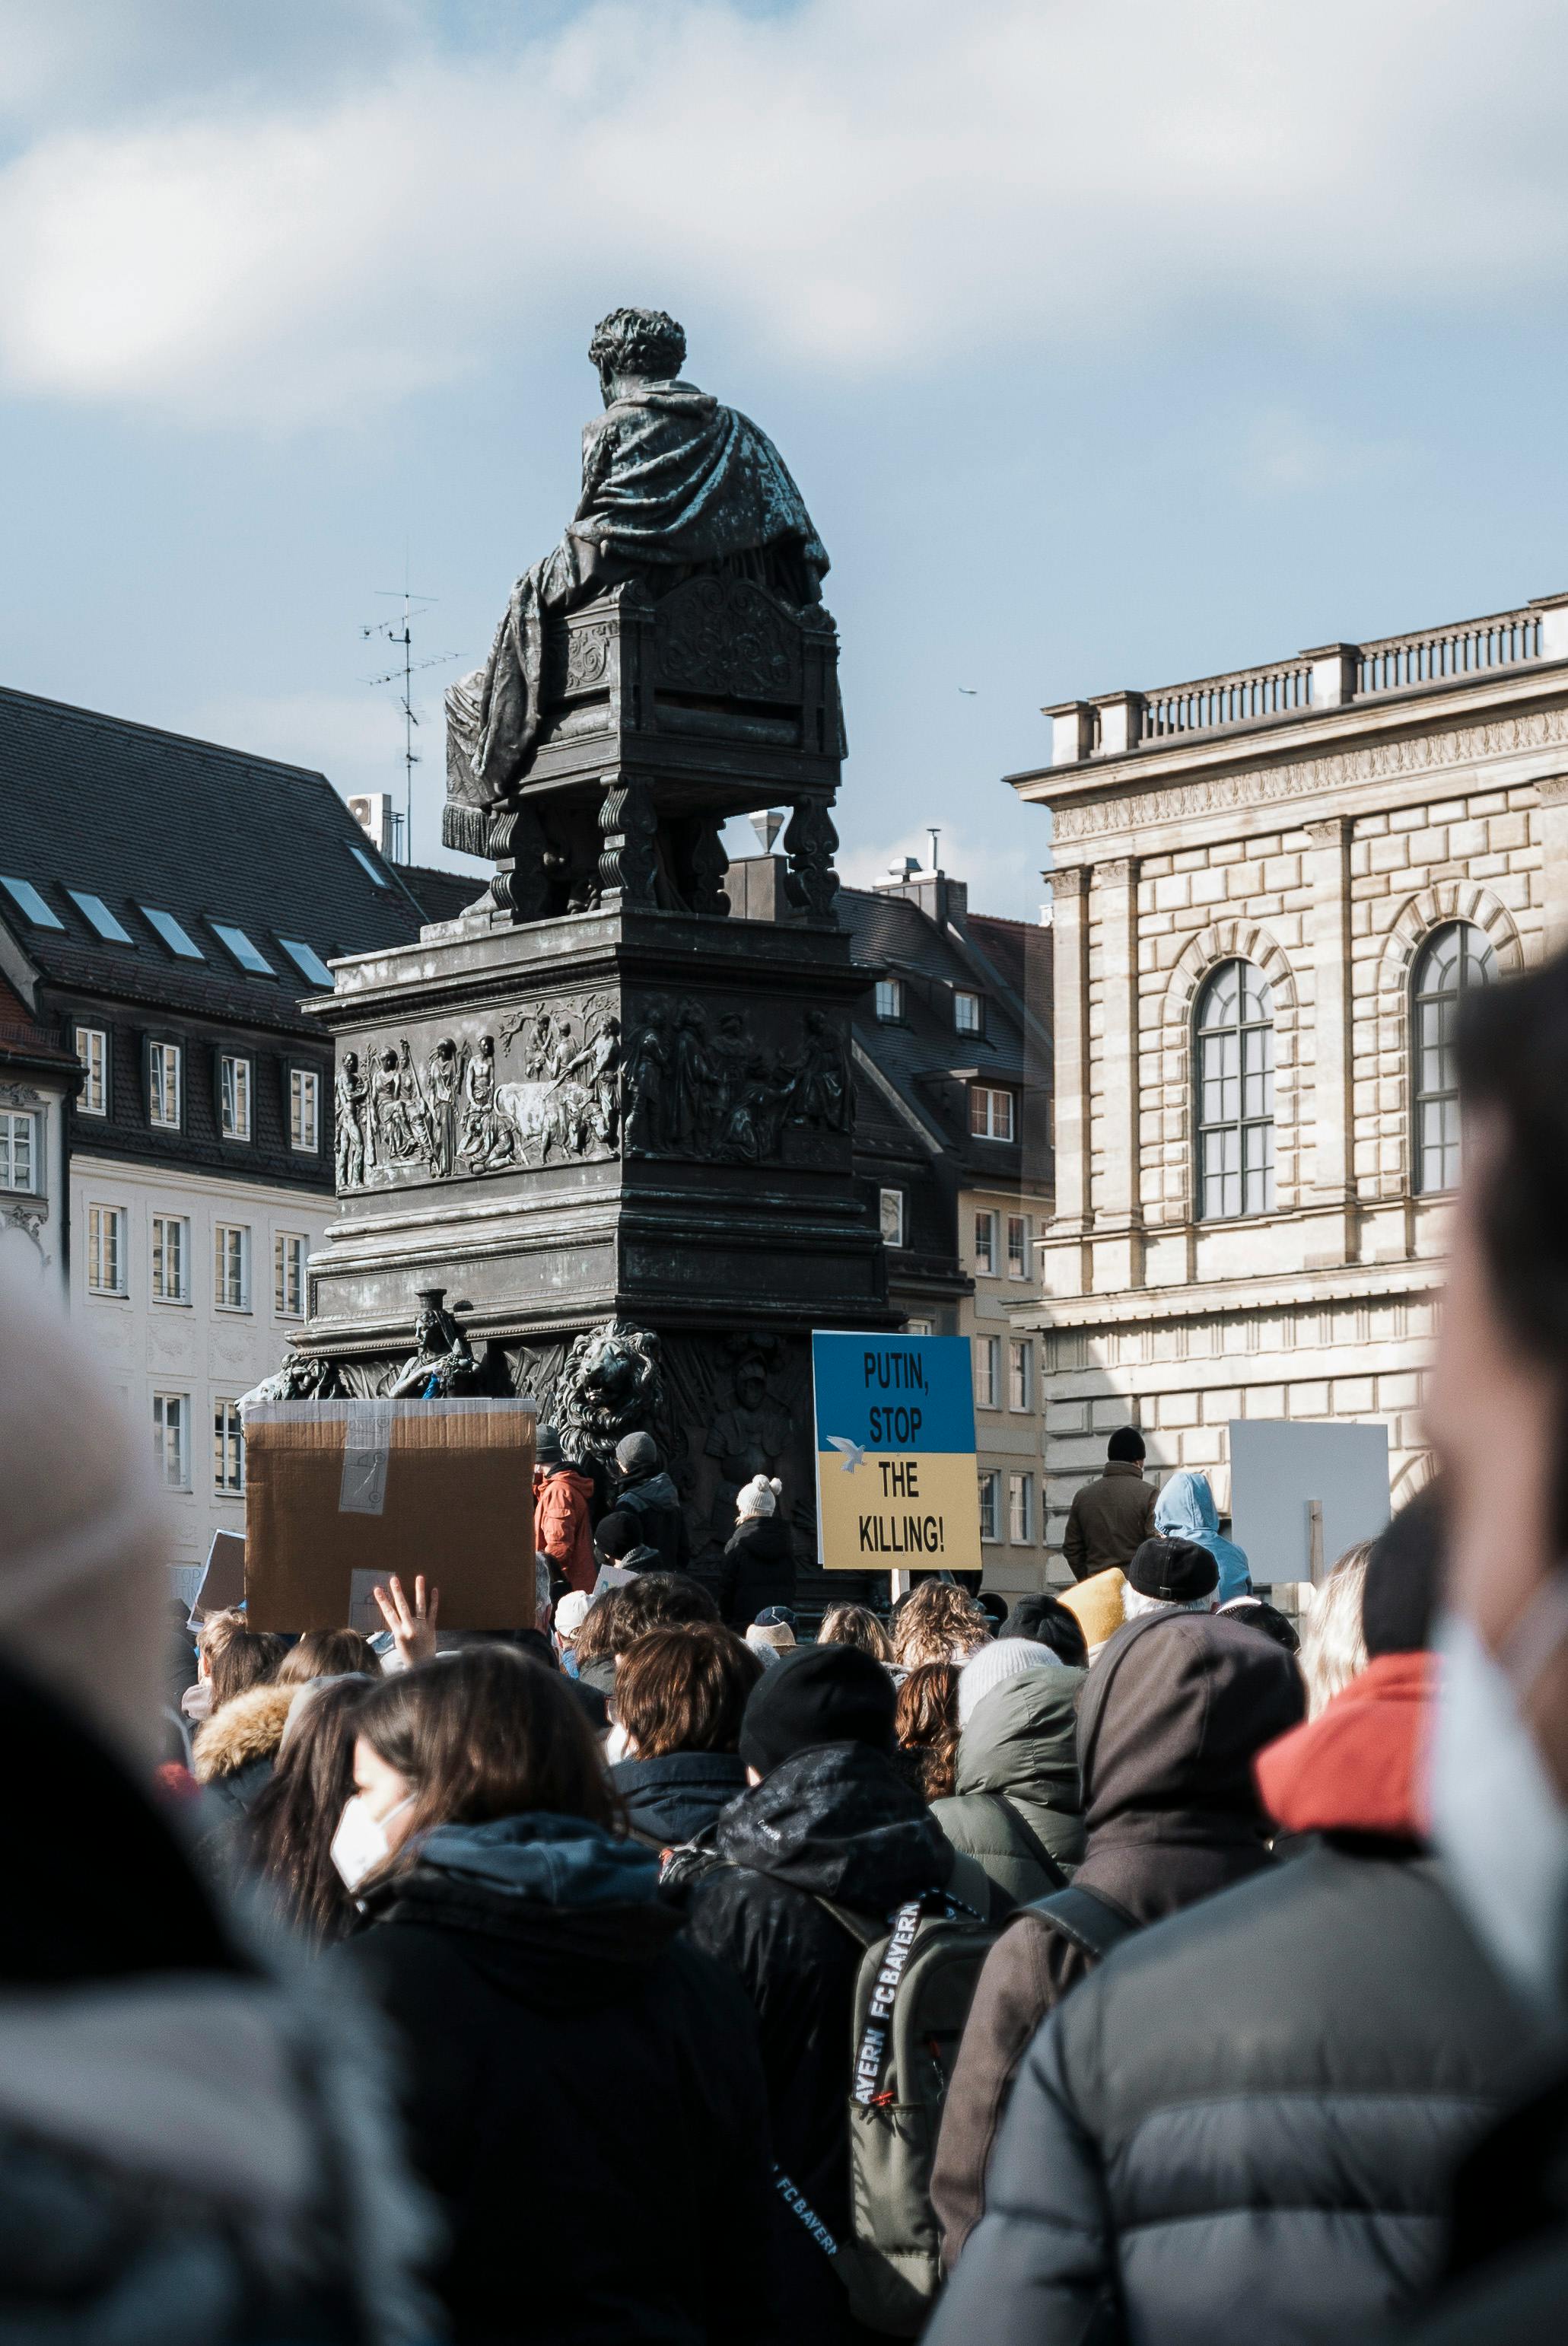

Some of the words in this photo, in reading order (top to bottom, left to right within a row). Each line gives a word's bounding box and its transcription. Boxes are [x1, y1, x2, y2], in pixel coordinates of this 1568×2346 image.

[864, 1351, 929, 1396] PUTIN,
[869, 1406, 923, 1444] STOP
[878, 1461, 920, 1498] THE
[858, 1515, 945, 1553] KILLING!
[854, 2026, 886, 2105] AYERN
